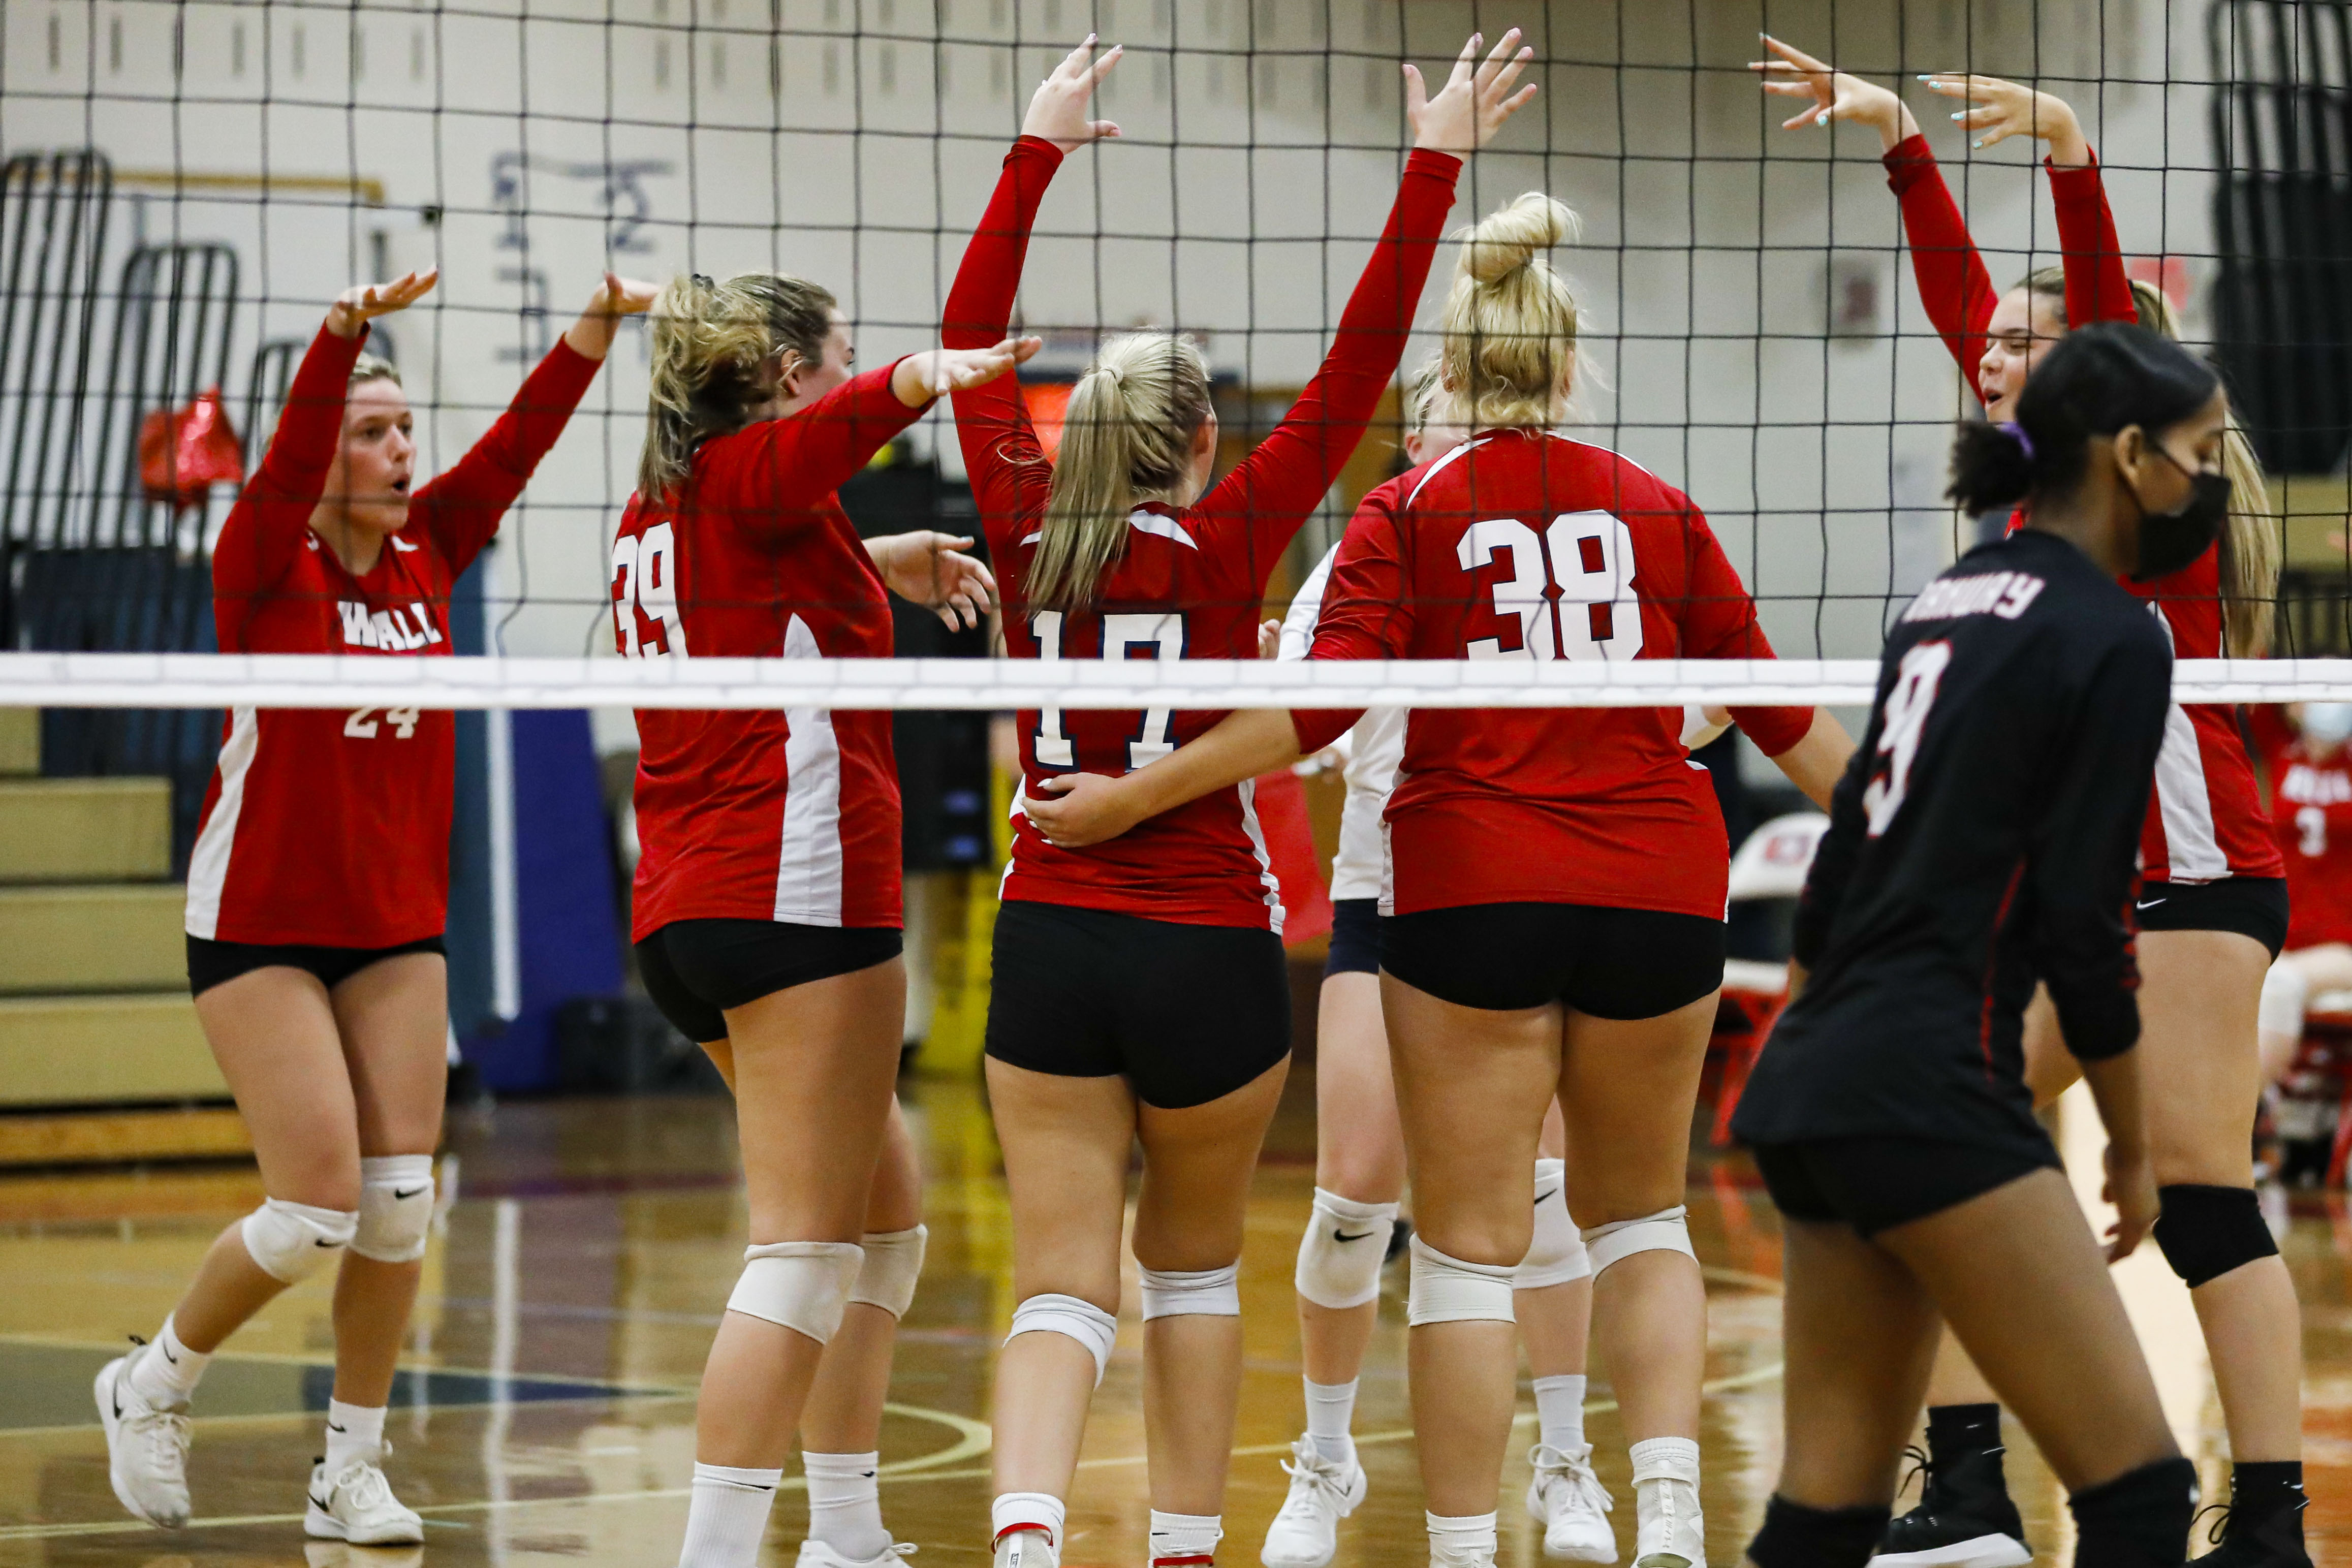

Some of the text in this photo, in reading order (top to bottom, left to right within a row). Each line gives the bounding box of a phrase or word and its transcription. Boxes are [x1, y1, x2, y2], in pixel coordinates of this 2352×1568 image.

[337, 600, 443, 651] WALL
[611, 521, 689, 658] 39
[1456, 509, 1643, 660] 38
[343, 706, 420, 739] 24
[1030, 610, 1188, 771] 17
[1863, 637, 1954, 839] 9
